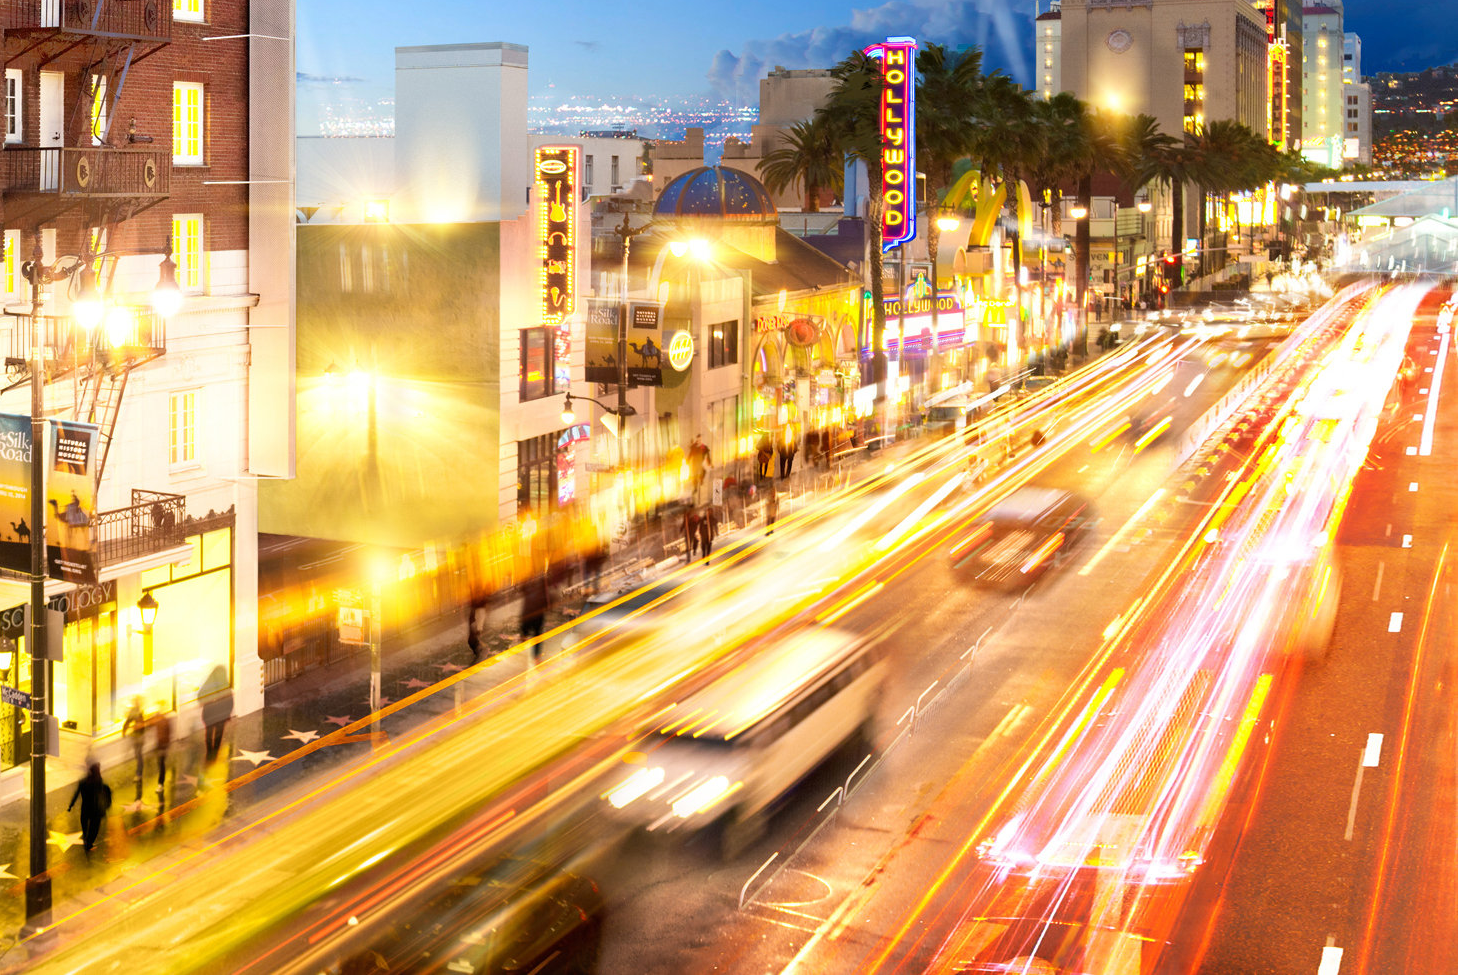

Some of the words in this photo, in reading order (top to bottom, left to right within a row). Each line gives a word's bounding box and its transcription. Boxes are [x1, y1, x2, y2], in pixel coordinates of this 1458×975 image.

[884, 49, 905, 226] HOLLYWOOD
[6, 430, 29, 450] Silk
[59, 439, 86, 447] NATURAL
[58, 445, 86, 453] HISTORY
[58, 451, 86, 460] MUSEUM
[1, 582, 113, 631] SCTOLOGY
